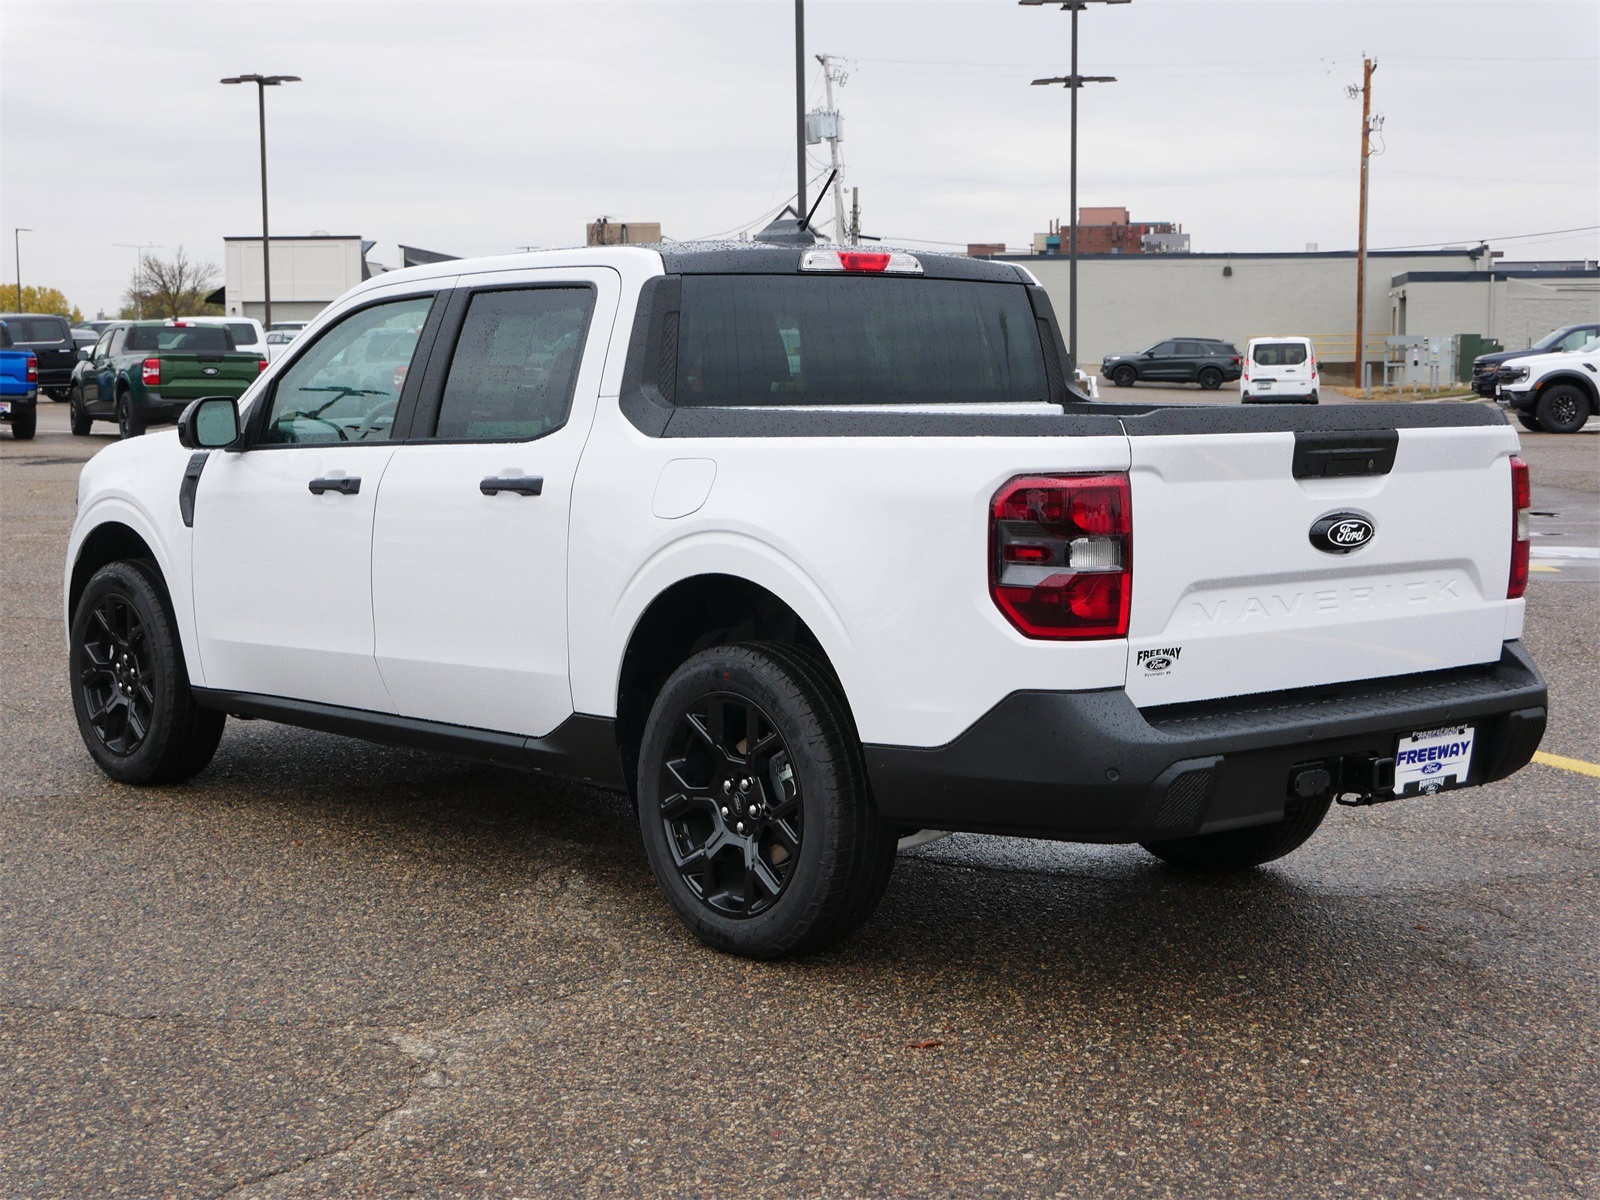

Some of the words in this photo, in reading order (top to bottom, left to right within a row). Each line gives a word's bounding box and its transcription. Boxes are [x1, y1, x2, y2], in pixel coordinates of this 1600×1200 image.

[1337, 524, 1365, 542] Ford
[1193, 578, 1460, 625] MAVERICK
[1137, 647, 1182, 666] FREEWAY
[1149, 659, 1168, 669] Ford
[1397, 741, 1470, 766] FREEWAY
[1423, 763, 1440, 774] Ford
[1419, 776, 1445, 791] FREEWAY
